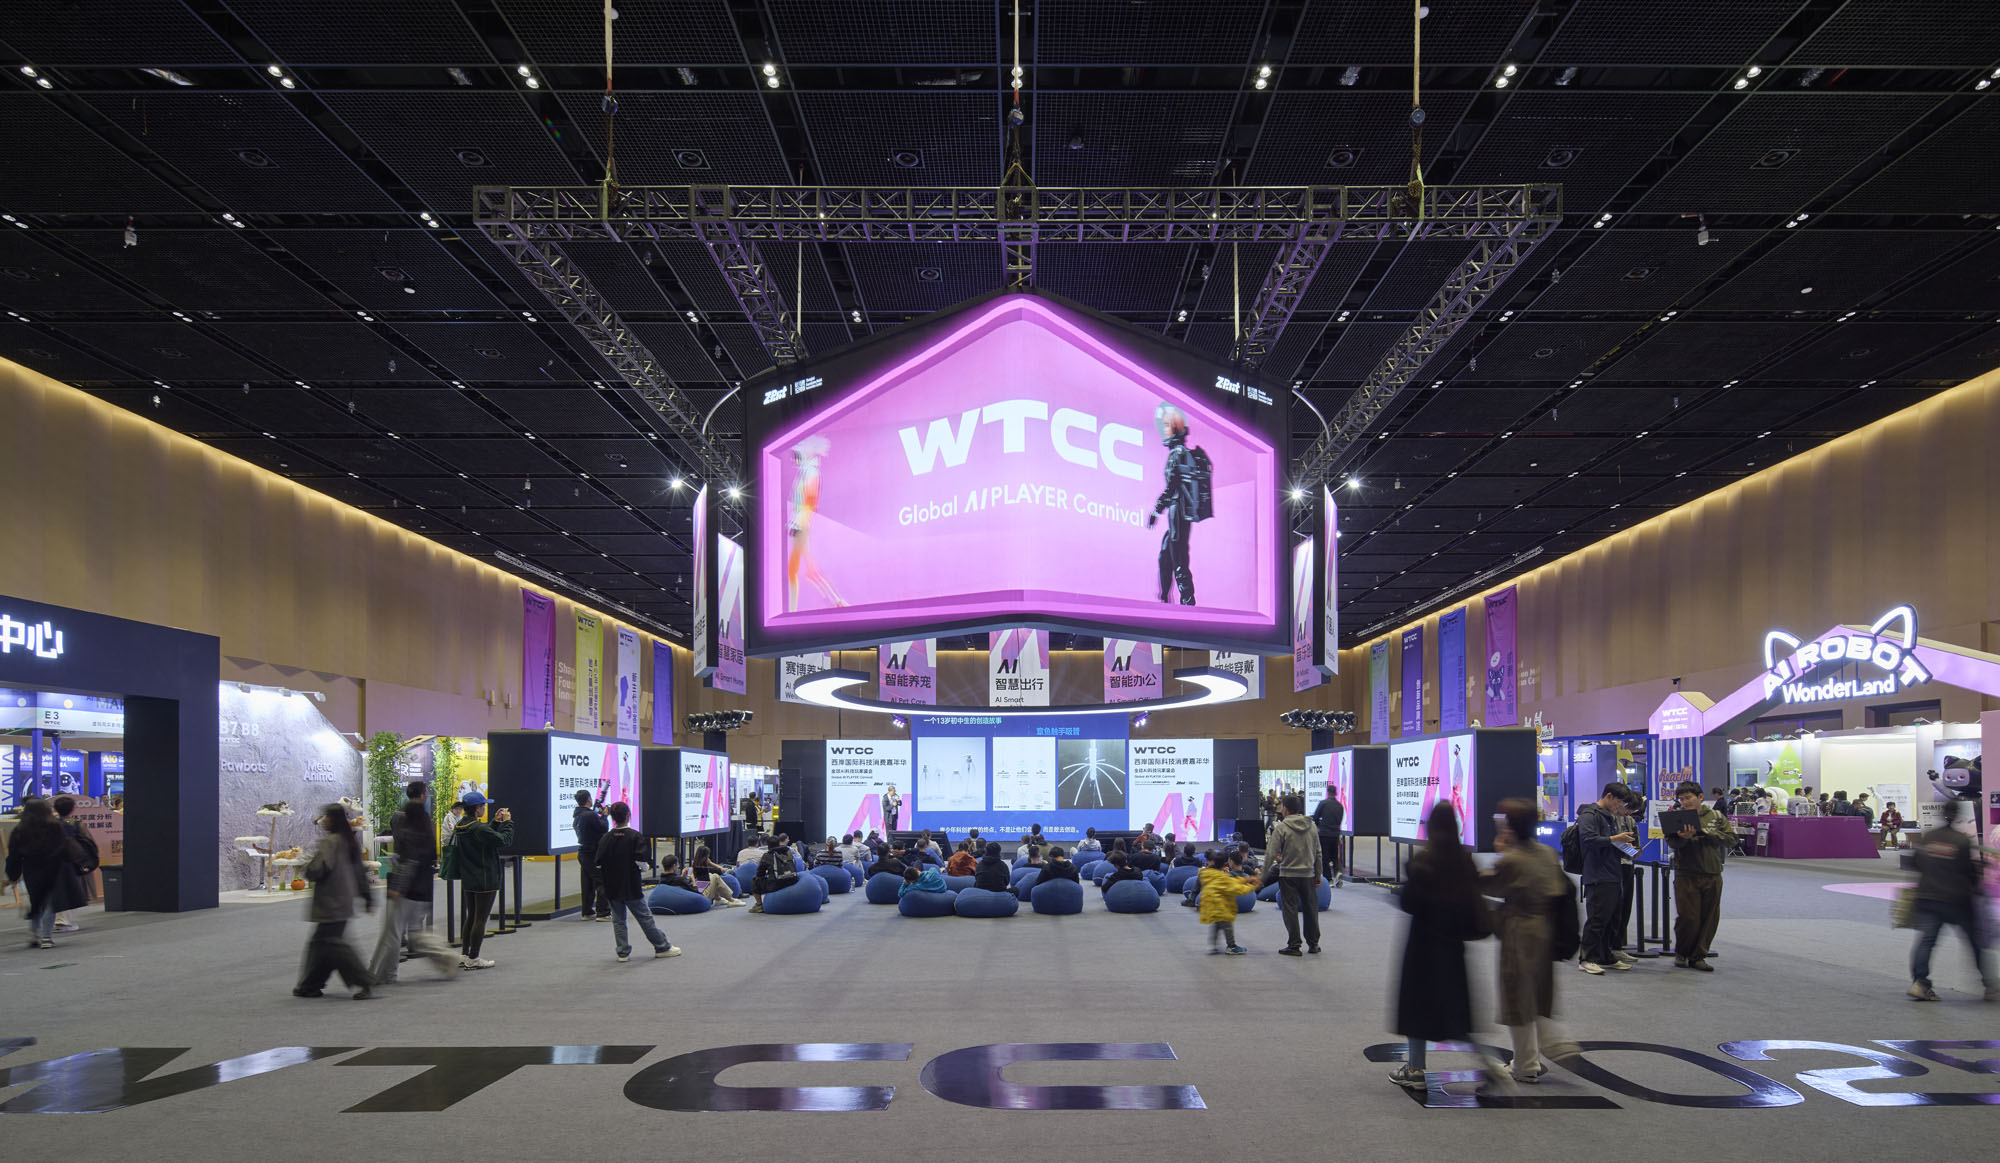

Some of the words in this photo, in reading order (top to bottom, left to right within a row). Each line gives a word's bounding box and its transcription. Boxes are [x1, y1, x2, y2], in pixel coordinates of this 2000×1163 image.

[899, 400, 1144, 481] WTCC
[899, 500, 958, 528] Global
[964, 488, 989, 514] AI
[991, 483, 1068, 512] PLAYER
[1072, 495, 1145, 528] Carnival
[577, 615, 595, 628] WTCC
[0, 614, 64, 660] 中心
[619, 632, 633, 643] WTCC
[1404, 632, 1418, 643] WTCC
[886, 653, 907, 670] AI
[997, 658, 1018, 674] AI
[1111, 655, 1131, 672] AI
[1763, 659, 1794, 700] AI
[1797, 634, 1930, 688] ROBOT
[885, 673, 932, 689] 智能养宠
[995, 678, 1044, 690] 智慧出行
[1110, 673, 1157, 689] 智能办公
[1782, 674, 1895, 704] WonderLand
[1662, 707, 1688, 716] WTCC
[831, 747, 874, 755] WTCC
[1134, 746, 1176, 754] WTCC
[219, 760, 268, 774] Pawbots
[306, 760, 334, 773] Meta
[559, 754, 590, 767] WTCC
[1396, 756, 1420, 768] WTCC
[685, 764, 701, 773] WTCC
[1309, 766, 1323, 774] WTCC
